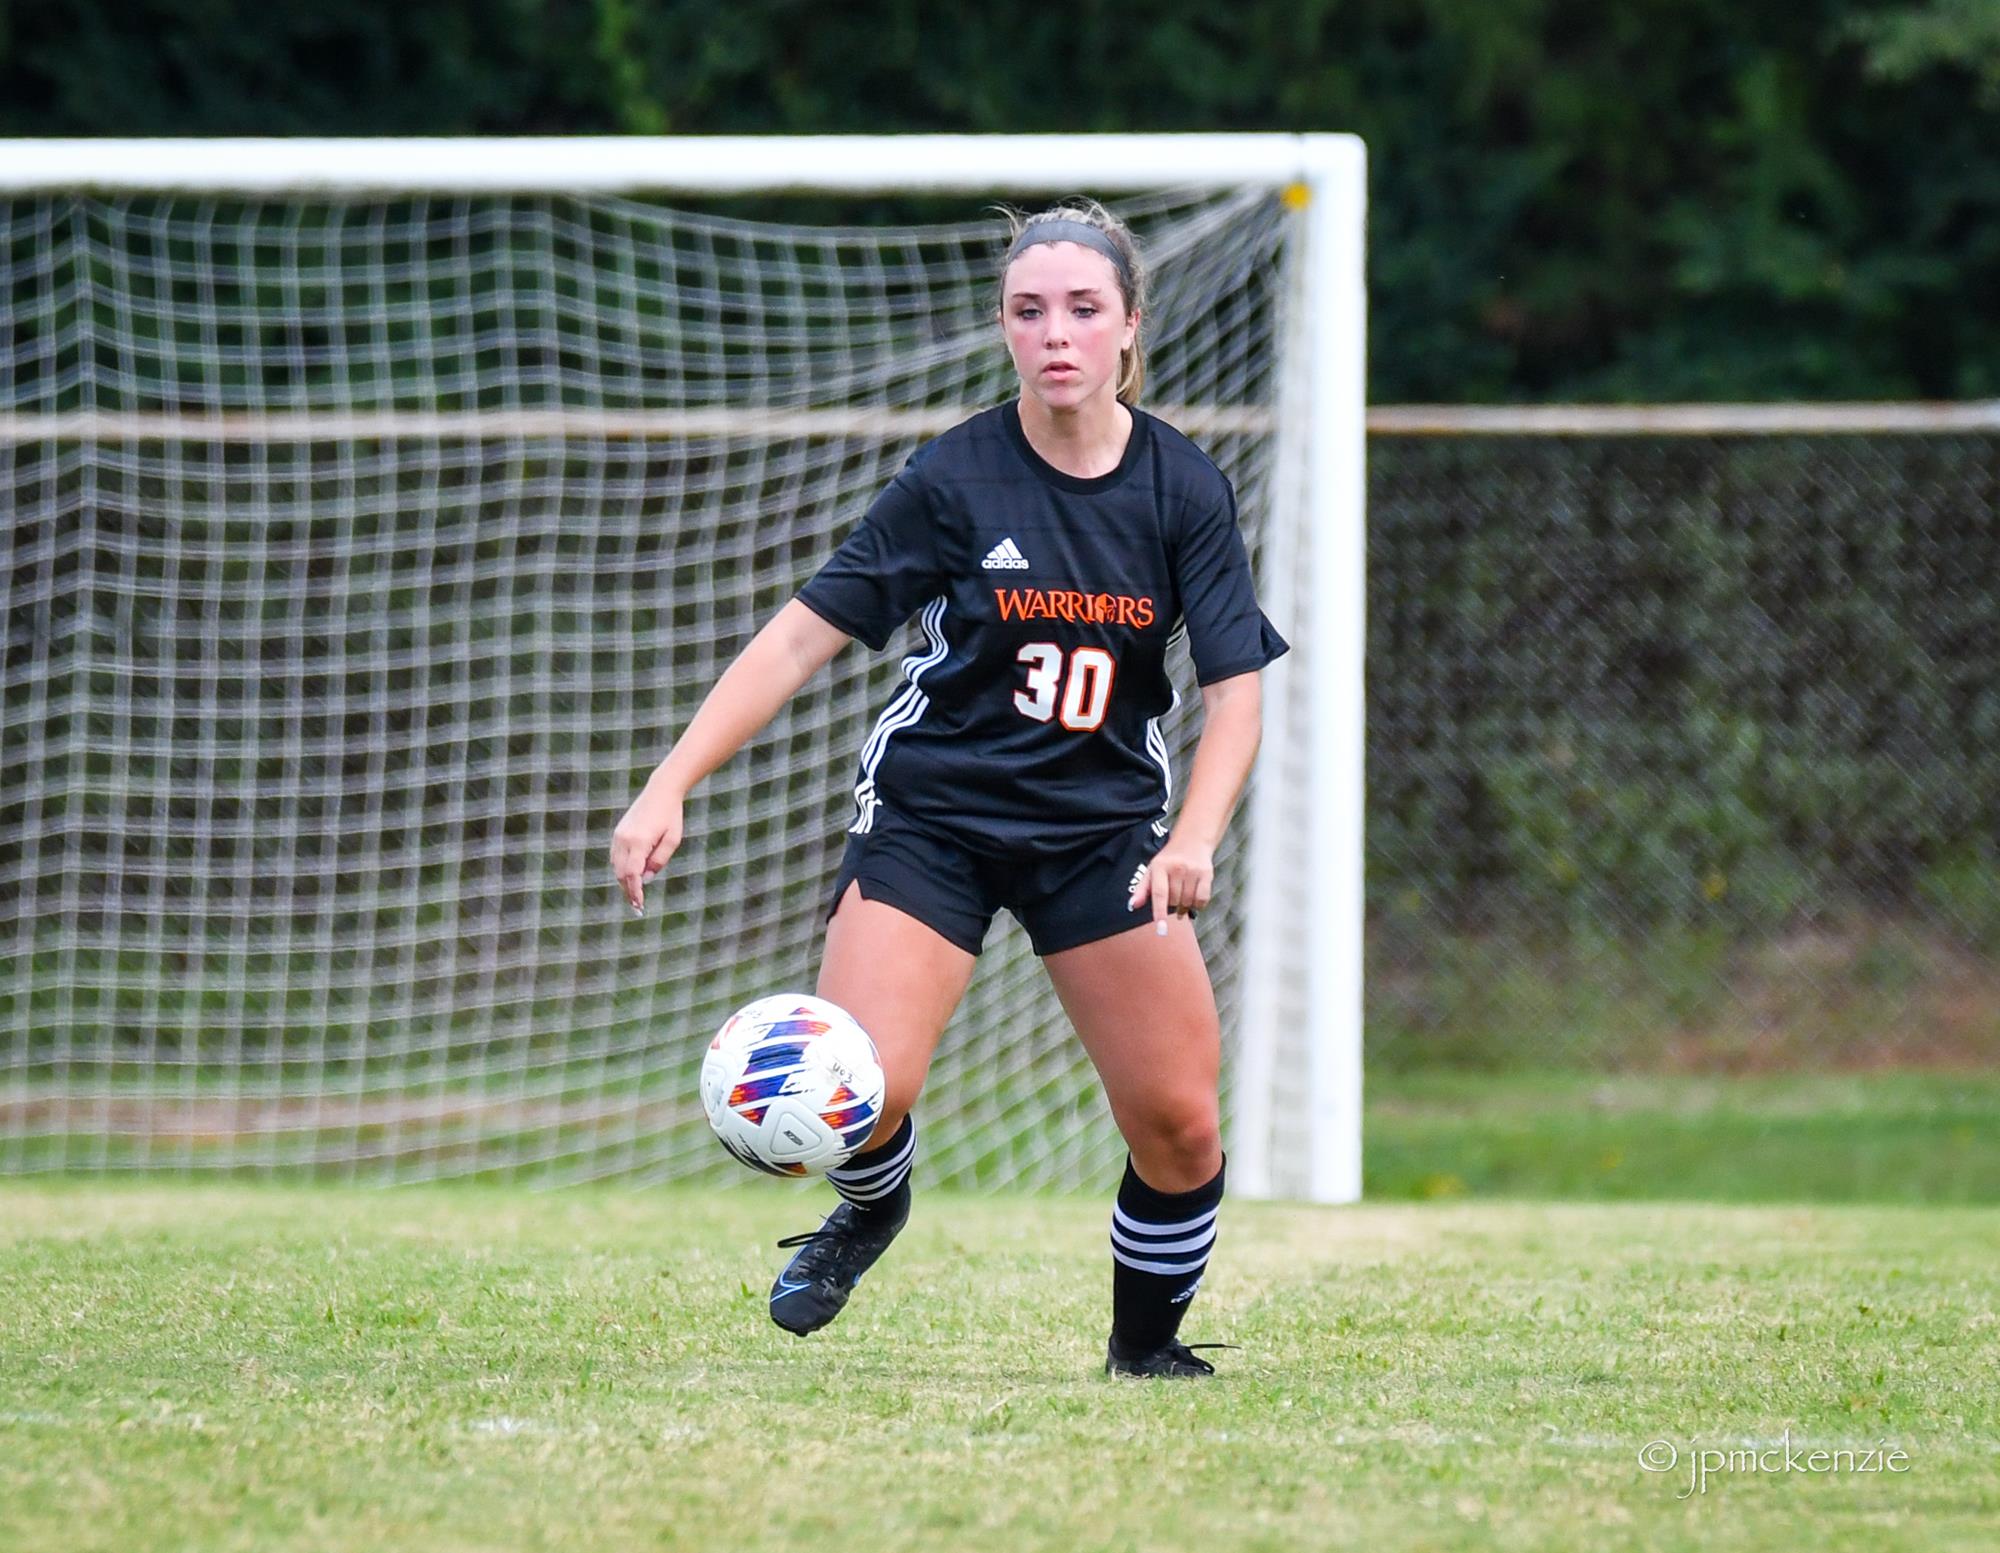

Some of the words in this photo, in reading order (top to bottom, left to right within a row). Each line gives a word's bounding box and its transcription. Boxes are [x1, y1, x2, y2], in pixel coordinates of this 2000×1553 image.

[981, 556, 1030, 570] adidas
[994, 588, 1155, 629] WARRIORS
[1013, 641, 1116, 733] 30
